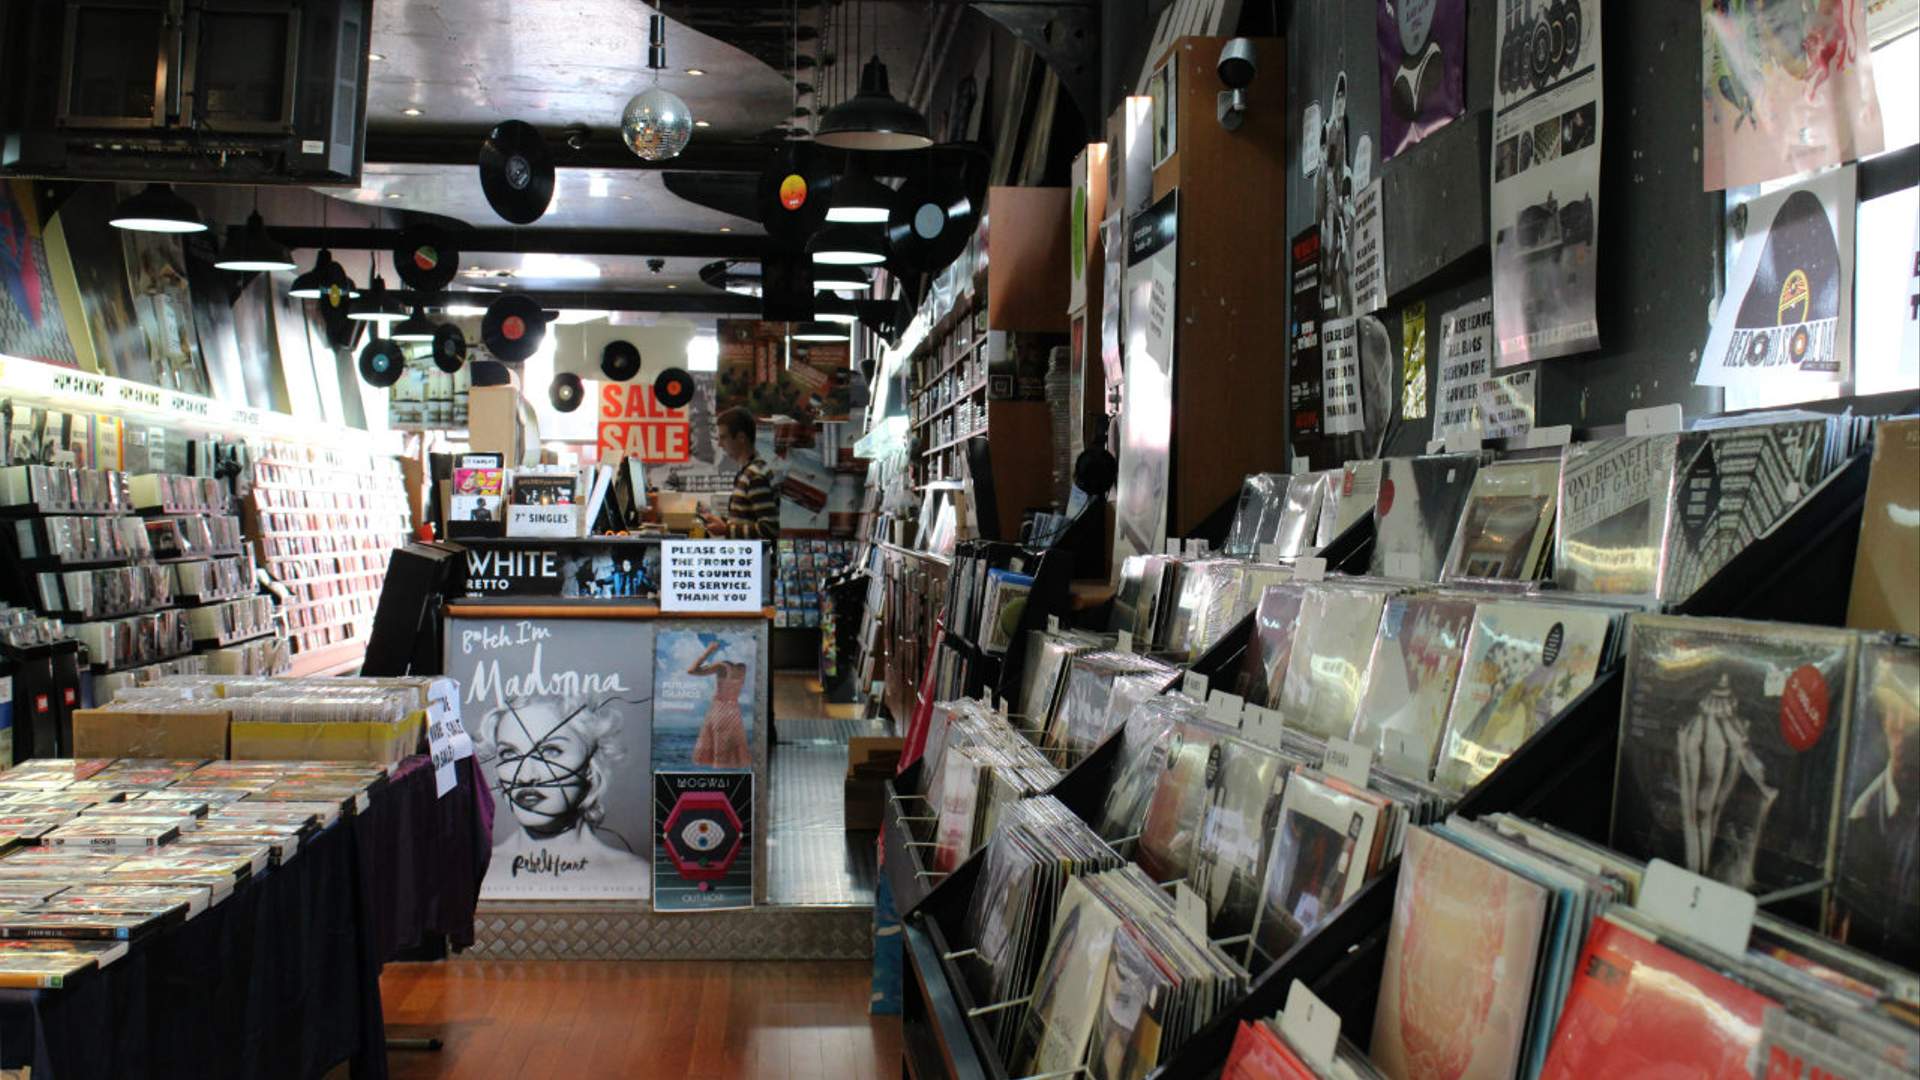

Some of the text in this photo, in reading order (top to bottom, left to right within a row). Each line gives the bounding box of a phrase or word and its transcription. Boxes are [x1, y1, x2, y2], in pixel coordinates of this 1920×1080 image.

[603, 423, 684, 460] SALE
[528, 513, 568, 524] SINGLES
[671, 546, 752, 554] PLEASE GO TO
[465, 550, 557, 577] WHITE
[671, 558, 752, 566] THE FRONT OF
[672, 570, 751, 578] THE COUNTER
[672, 581, 751, 590] FOR SERVICE.
[676, 593, 747, 601] THANK YOU
[515, 621, 552, 644] I'm
[465, 642, 631, 710] Madonna
[677, 777, 730, 788] MOGWAI
